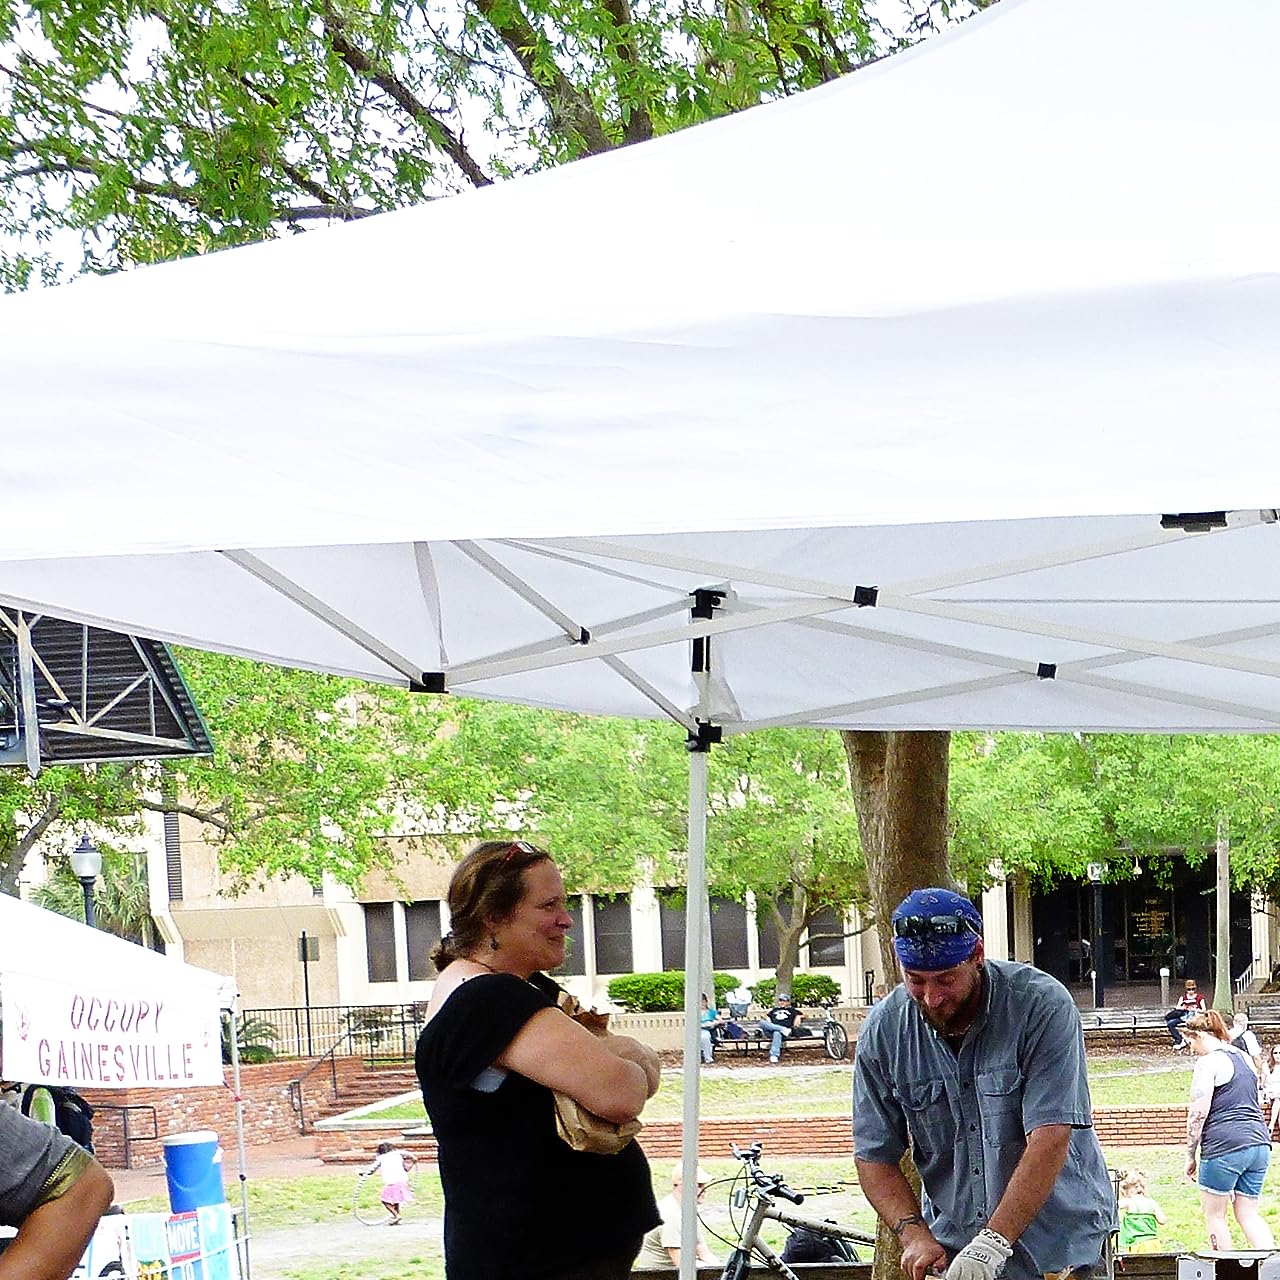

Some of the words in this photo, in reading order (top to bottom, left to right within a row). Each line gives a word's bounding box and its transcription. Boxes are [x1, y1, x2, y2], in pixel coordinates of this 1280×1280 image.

[71, 994, 164, 1033] OCCUPY
[38, 1038, 194, 1082] GAINESVILLE
[168, 1220, 201, 1255] MOVE
